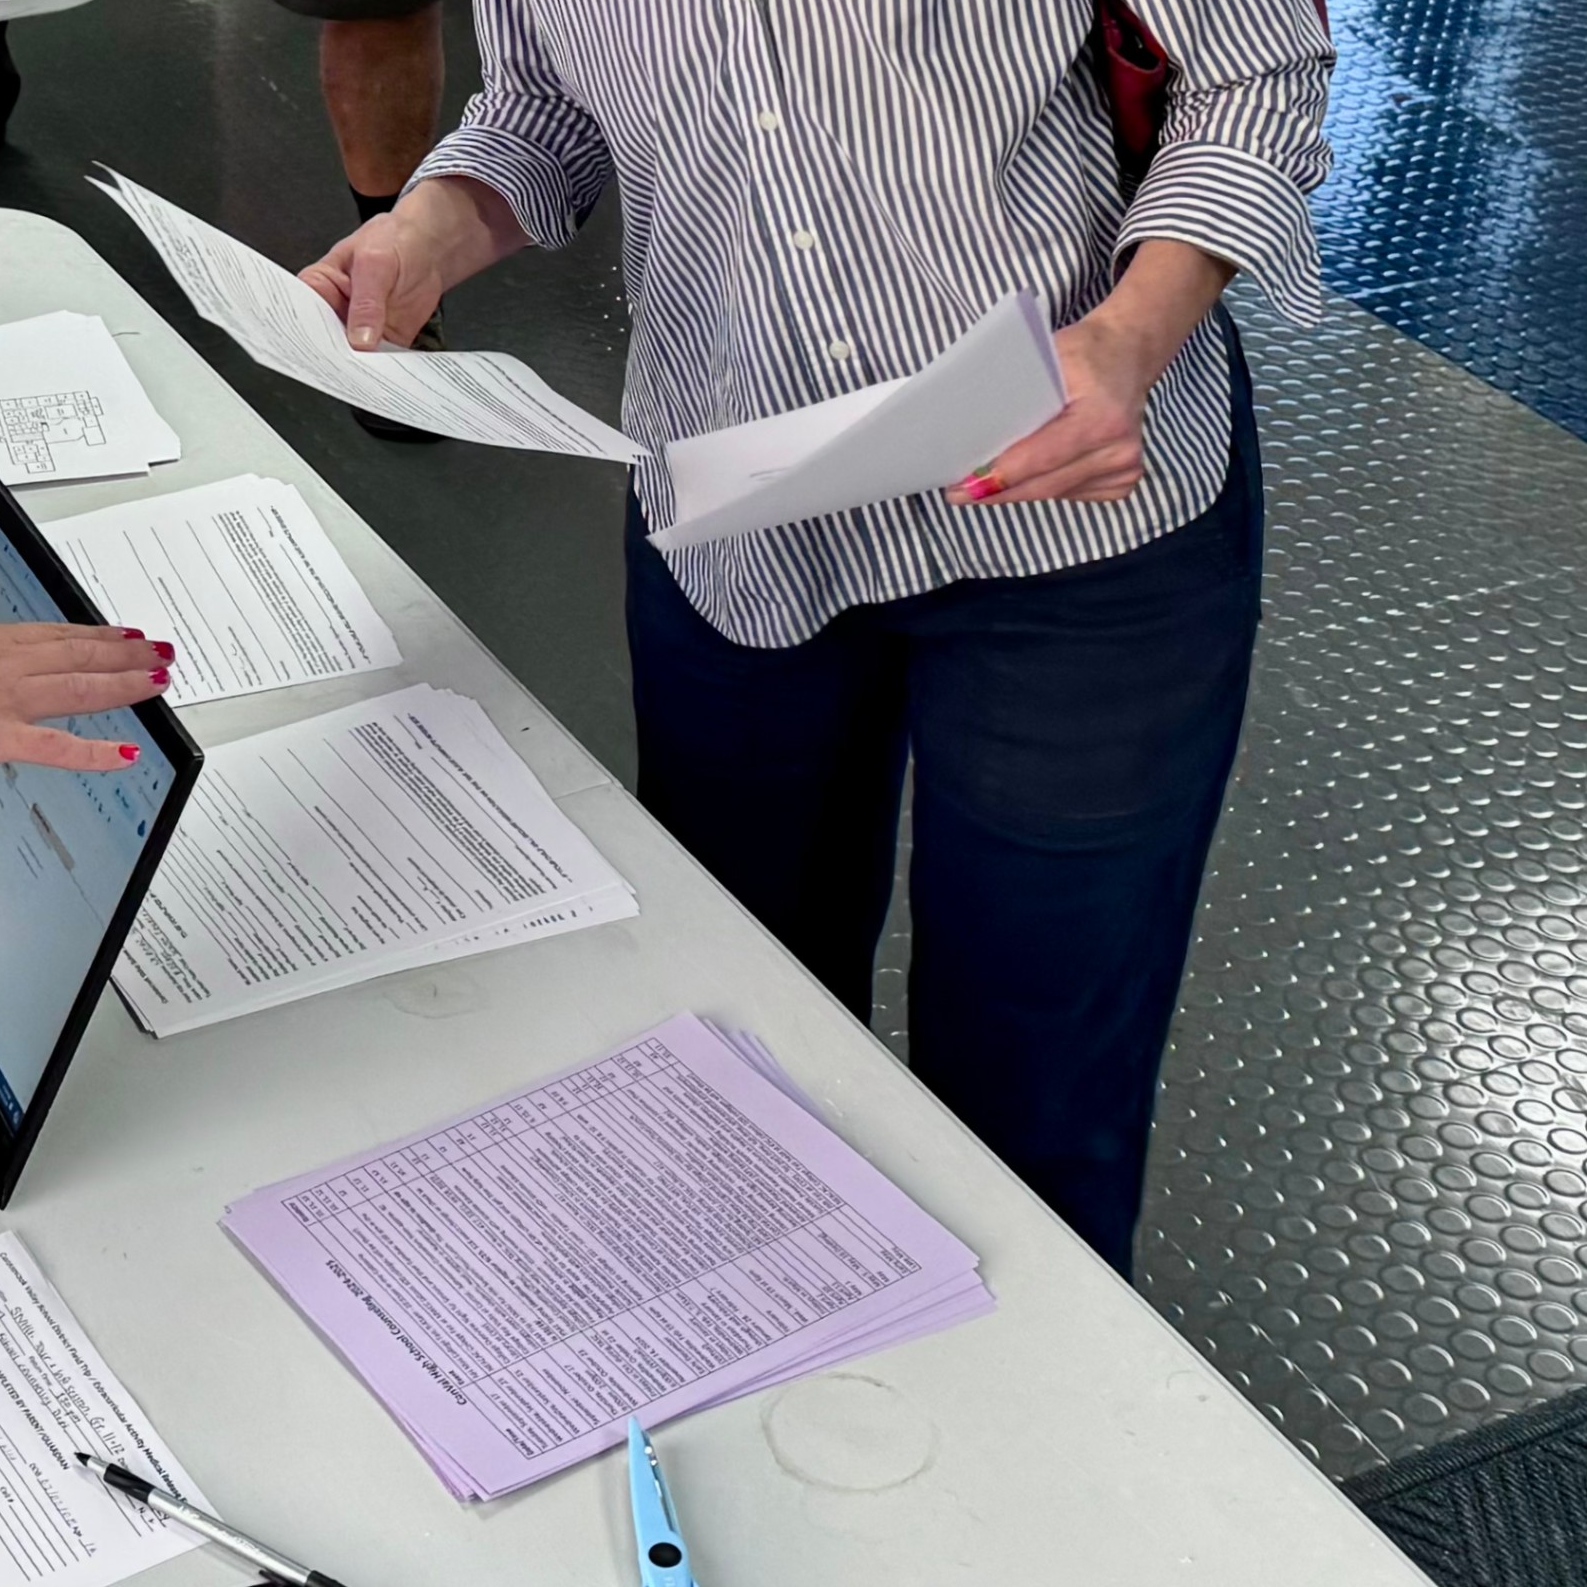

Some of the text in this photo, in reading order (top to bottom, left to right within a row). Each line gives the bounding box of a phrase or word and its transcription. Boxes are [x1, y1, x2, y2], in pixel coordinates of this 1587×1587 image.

[358, 1295, 403, 1336] Counseling
[395, 1334, 426, 1361] School
[419, 1358, 445, 1379] High
[436, 1377, 468, 1406] ConVal
[67, 1347, 85, 1365] Field
[77, 1363, 94, 1377] Trip
[123, 1423, 146, 1449] Activity
[141, 1448, 165, 1475] Medical
